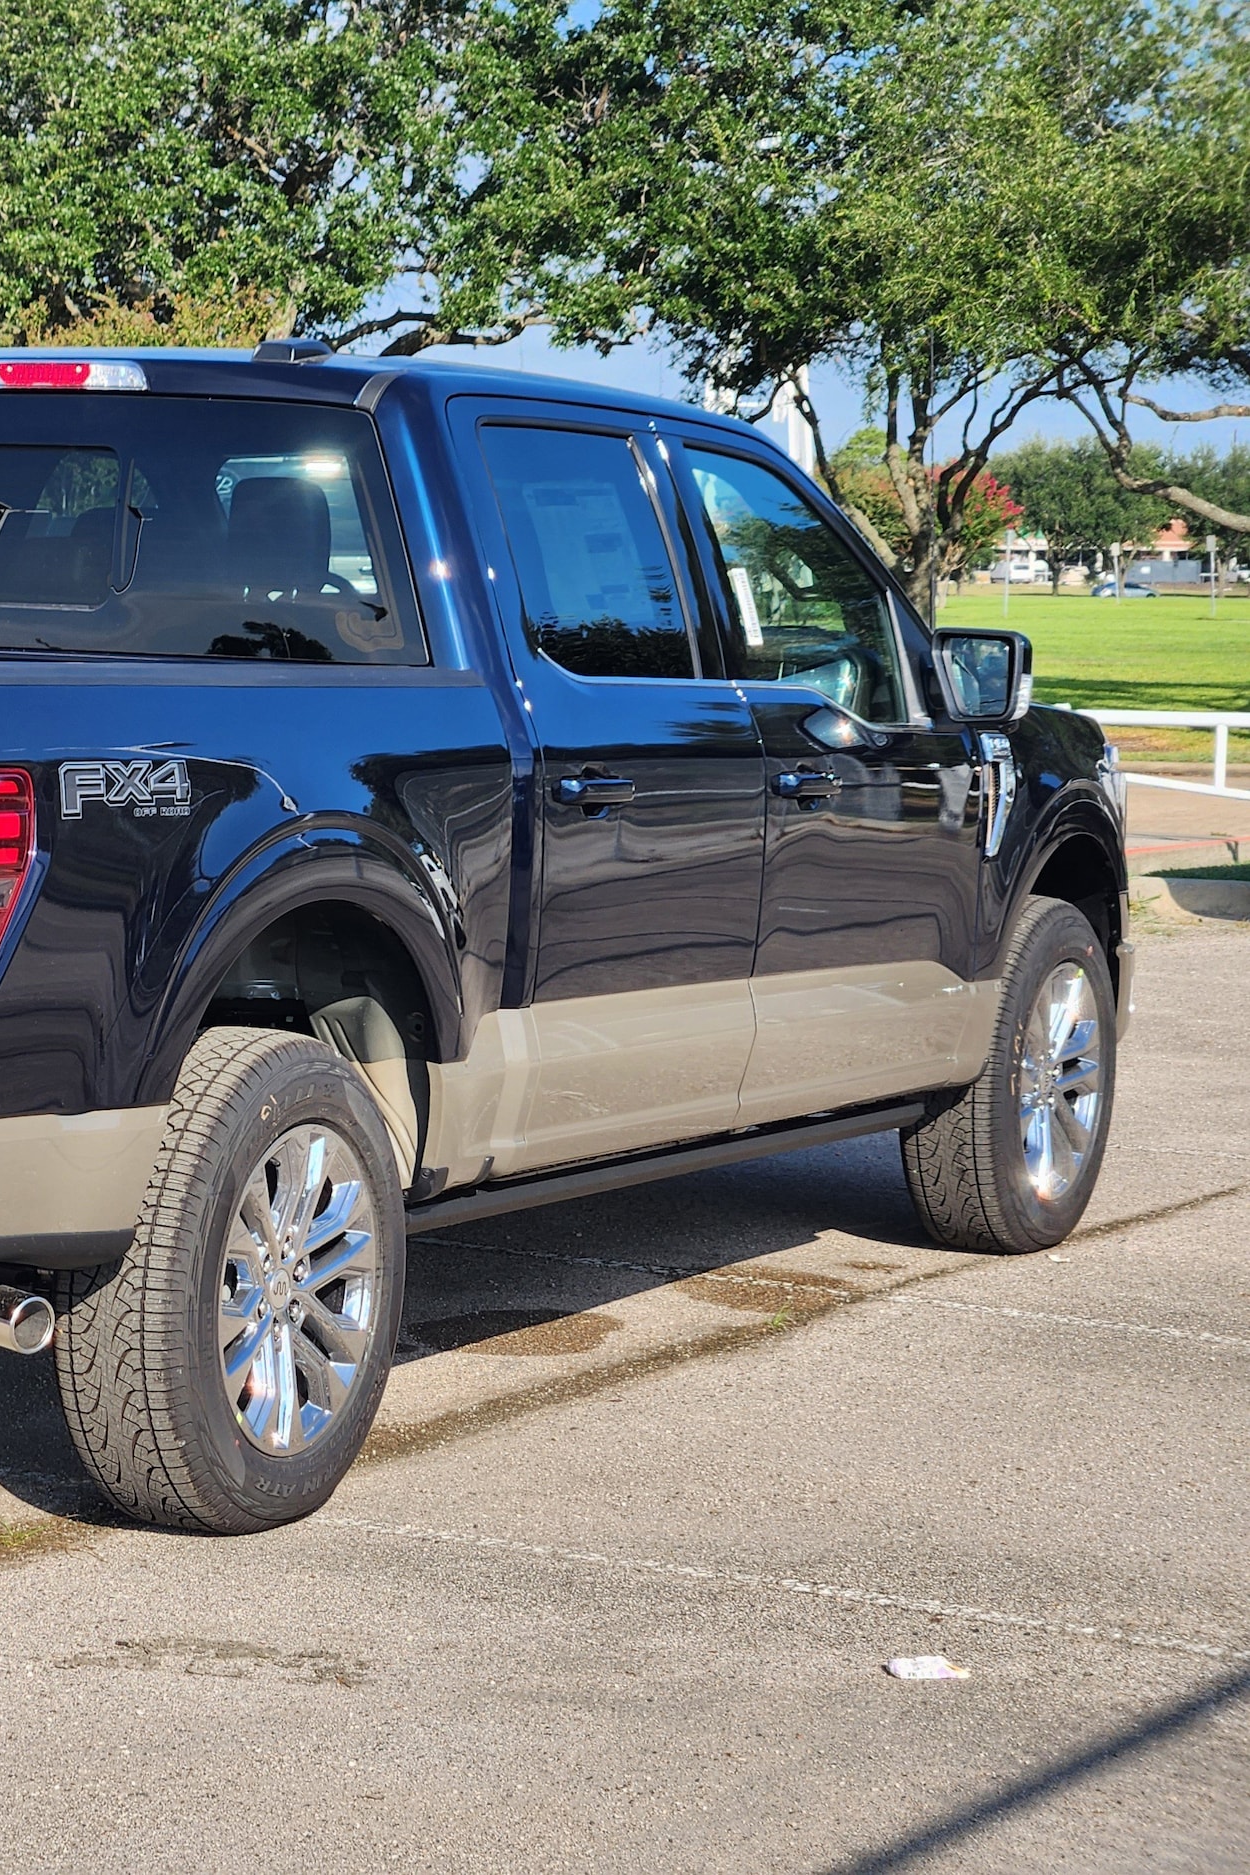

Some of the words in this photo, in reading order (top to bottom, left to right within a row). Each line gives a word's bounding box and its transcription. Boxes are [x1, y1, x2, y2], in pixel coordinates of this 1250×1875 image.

[57, 760, 192, 820] FX4
[133, 806, 158, 818] OFF
[159, 806, 191, 817] ROAD
